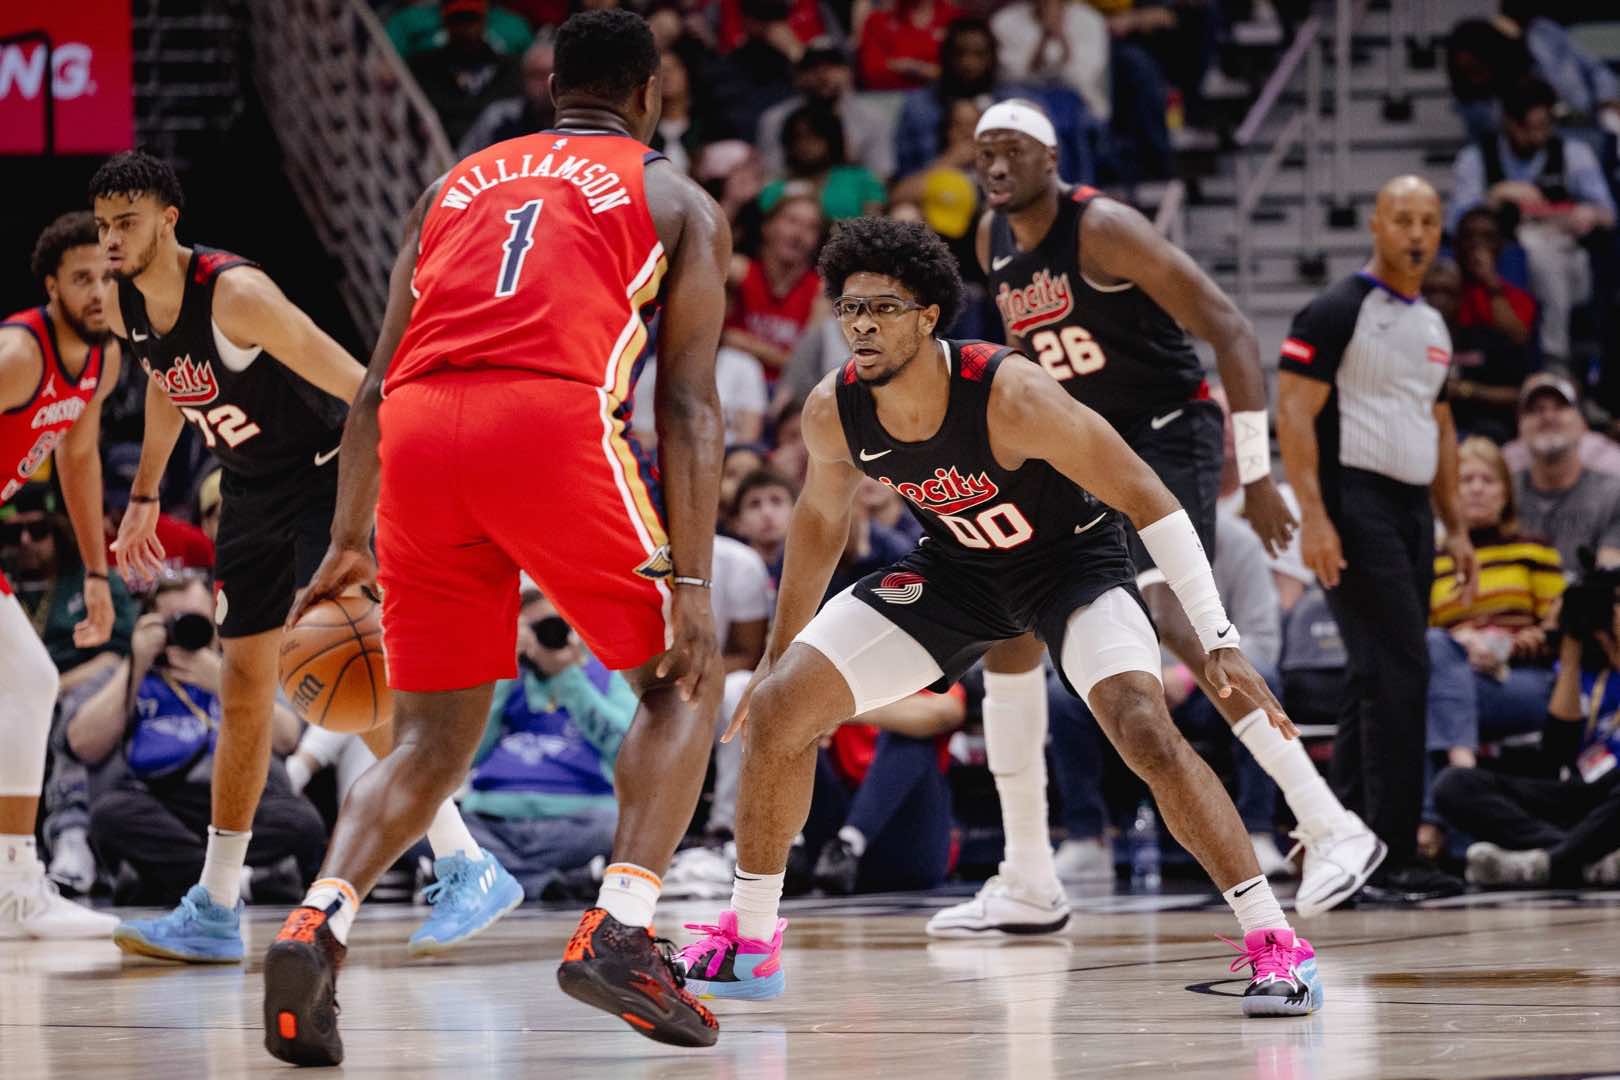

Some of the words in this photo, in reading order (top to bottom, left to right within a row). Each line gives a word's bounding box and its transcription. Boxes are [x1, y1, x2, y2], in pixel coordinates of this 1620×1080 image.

[440, 153, 631, 214] WILLIAMSON
[495, 199, 544, 297] 1
[1032, 325, 1106, 380] 26
